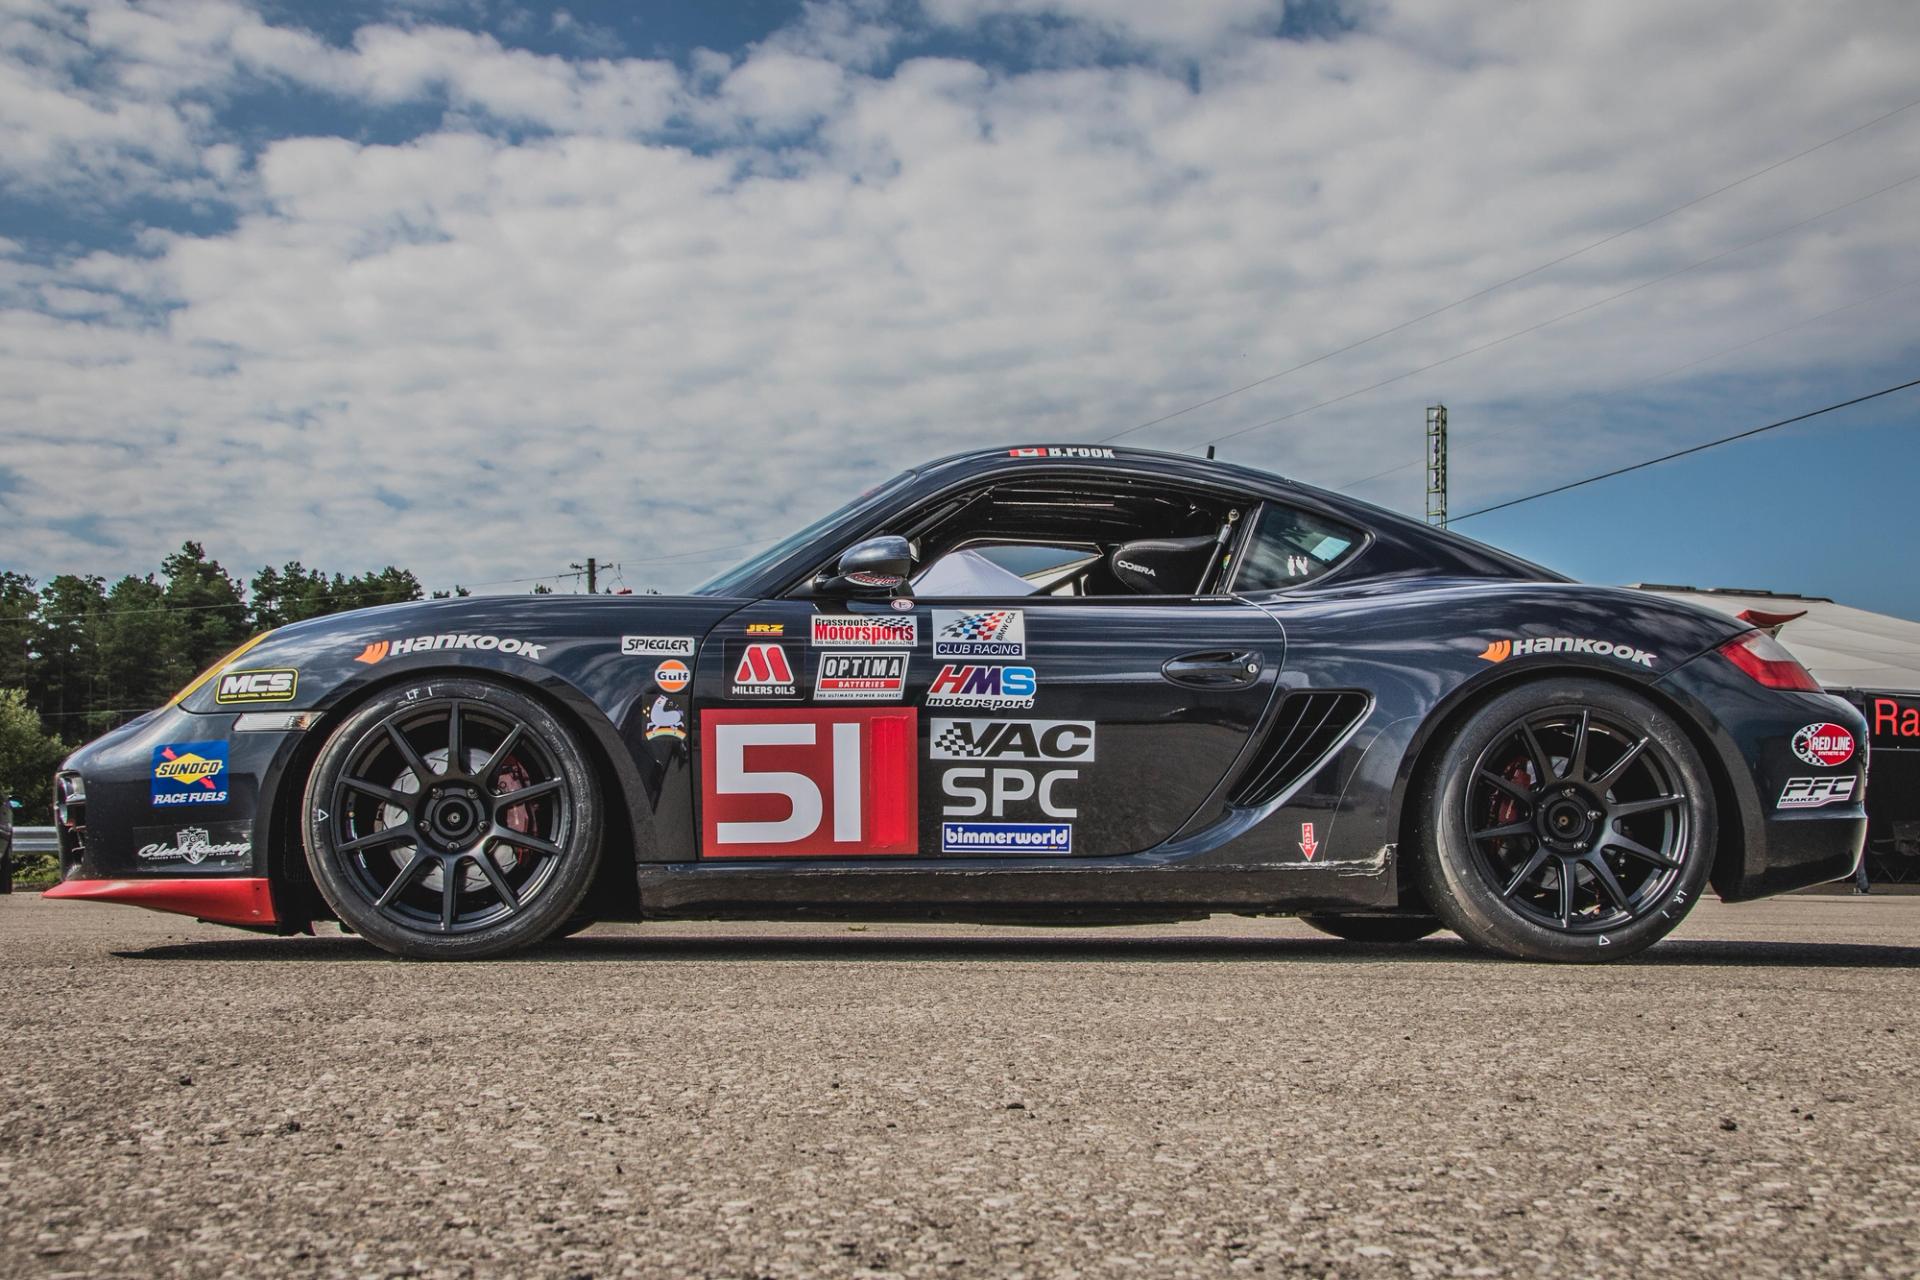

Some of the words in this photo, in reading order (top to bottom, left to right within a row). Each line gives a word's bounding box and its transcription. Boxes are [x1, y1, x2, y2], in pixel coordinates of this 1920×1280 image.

[1117, 560, 1156, 577] COBRA
[746, 623, 784, 633] JRZ
[815, 618, 869, 627] Grassroots
[815, 624, 914, 645] Motorsports
[624, 638, 689, 653] SPIEGLER
[938, 644, 970, 654] CLUB
[973, 645, 1020, 655] RACING
[657, 670, 689, 681] Gulf
[825, 659, 899, 676] OPTIMA
[221, 674, 293, 694] MCS
[928, 665, 1036, 696] HMS
[732, 686, 772, 695] MILLERS
[775, 686, 796, 695] OILS
[927, 697, 1034, 711] motorsport
[952, 722, 1092, 758] VAC
[1812, 737, 1830, 750] RED
[1832, 737, 1851, 750] LINE
[159, 762, 220, 776] SUNOCO
[716, 723, 861, 844] 51
[1784, 777, 1855, 797] PFC
[154, 794, 187, 804] RACE
[189, 791, 227, 802] FUELS
[942, 767, 1078, 818] SPC
[946, 827, 1067, 845] bimmerworld
